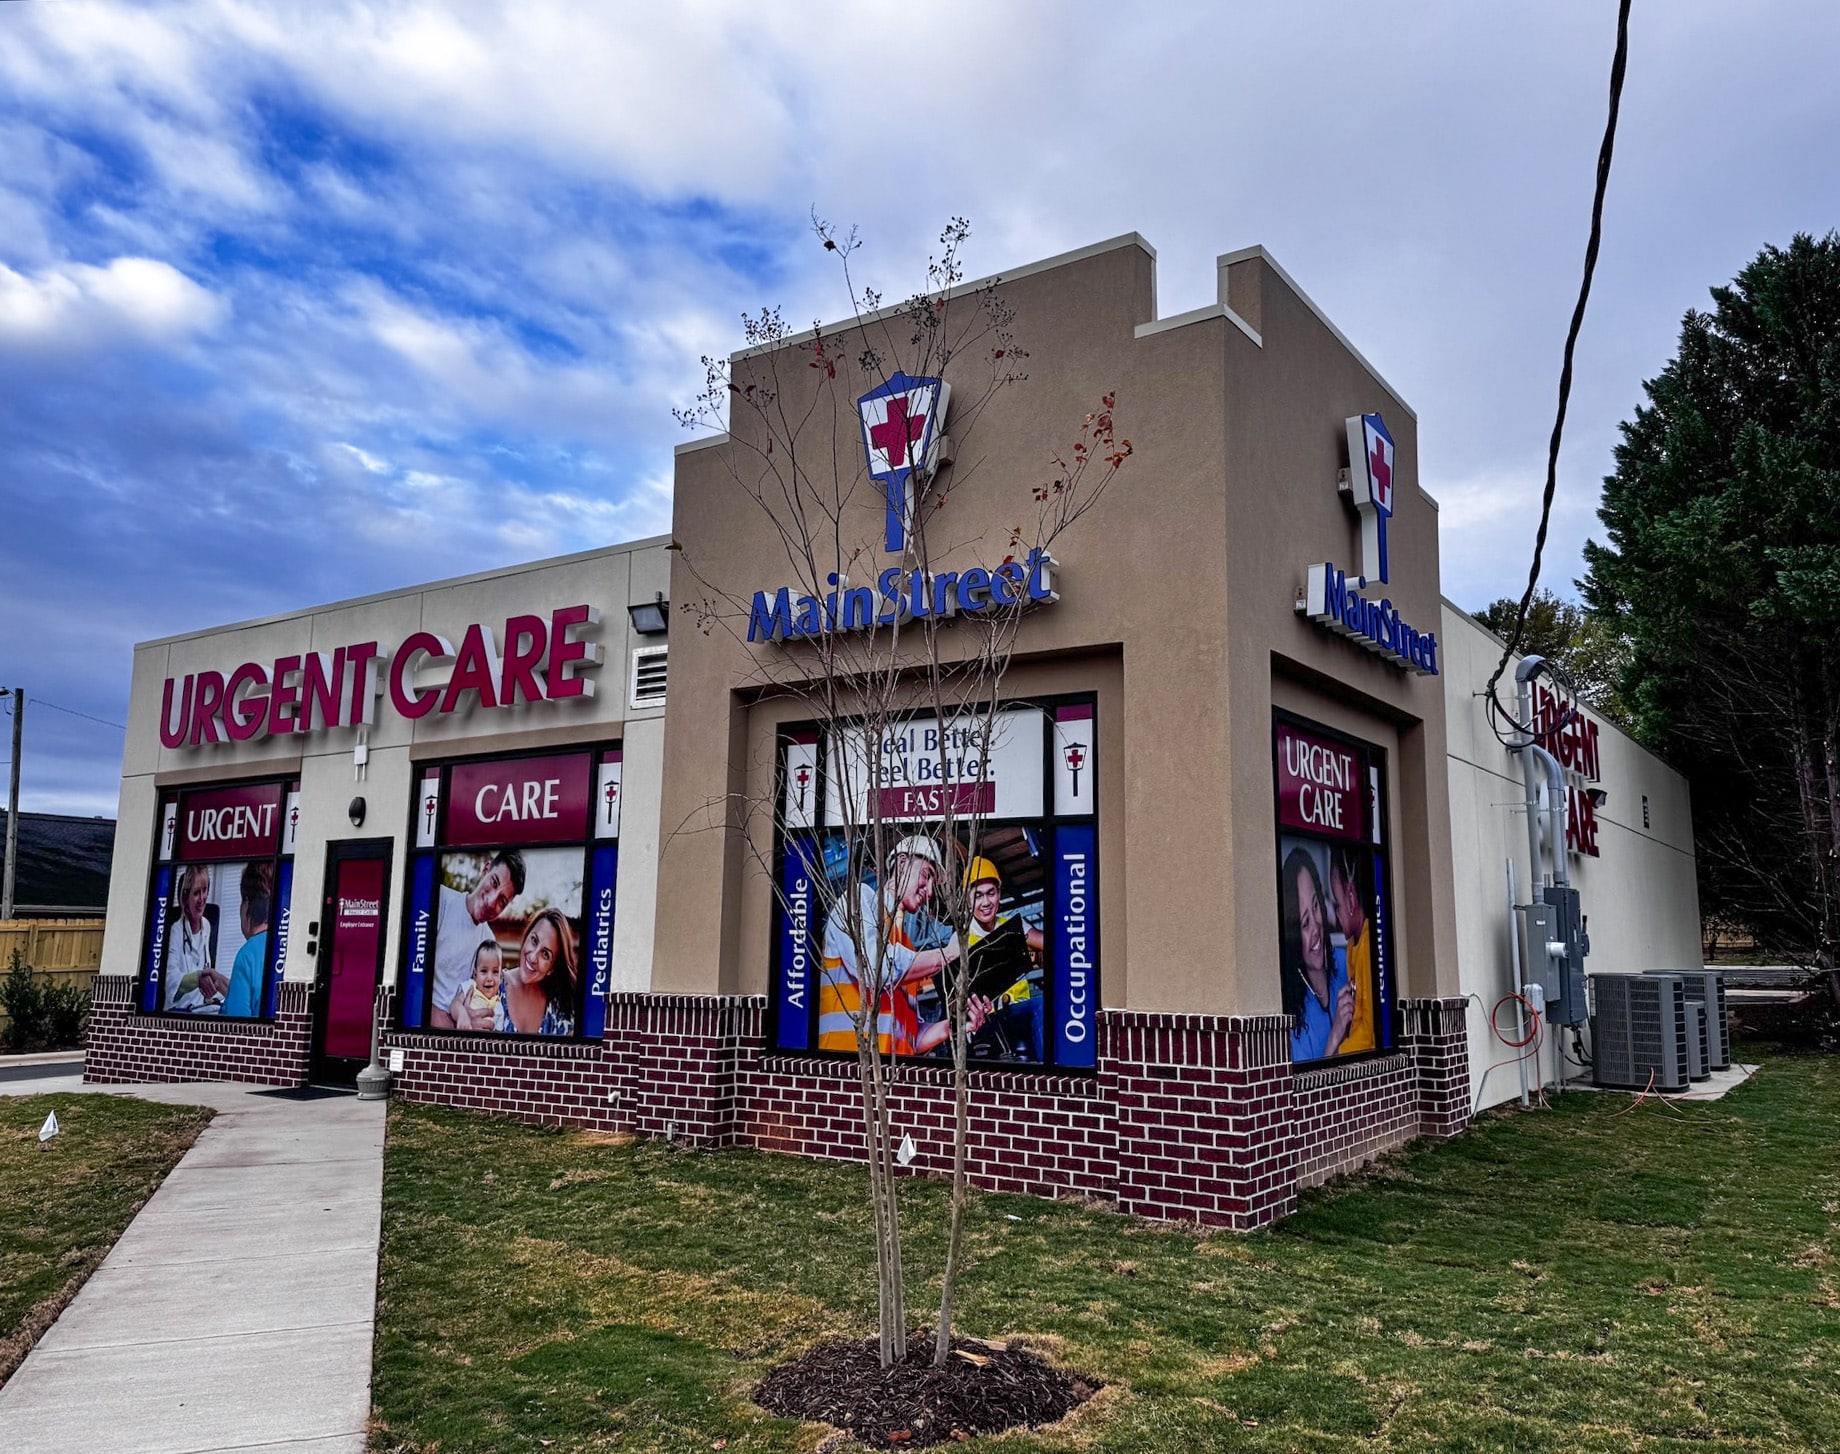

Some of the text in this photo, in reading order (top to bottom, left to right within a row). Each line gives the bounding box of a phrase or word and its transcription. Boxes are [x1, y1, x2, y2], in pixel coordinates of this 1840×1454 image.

[746, 547, 1050, 643] MainStreet
[1324, 562, 1439, 676] MainStreet
[160, 604, 591, 749] URGENT CARE
[866, 726, 996, 755] eal Bette.
[1285, 735, 1352, 792] URGENT
[1531, 678, 1601, 783] URGENT
[474, 778, 561, 824] CARE
[867, 756, 908, 783] eel
[186, 802, 277, 843] URGENT
[1299, 783, 1344, 830] CARE
[1560, 783, 1600, 858] ARE
[344, 898, 379, 909] MainStreet
[149, 896, 168, 983] Dedicated
[274, 907, 291, 974] Quality
[411, 909, 430, 973] Family
[591, 887, 612, 997] Pediatrics
[787, 878, 808, 1009] Affordable
[1062, 853, 1092, 1044] Occupational
